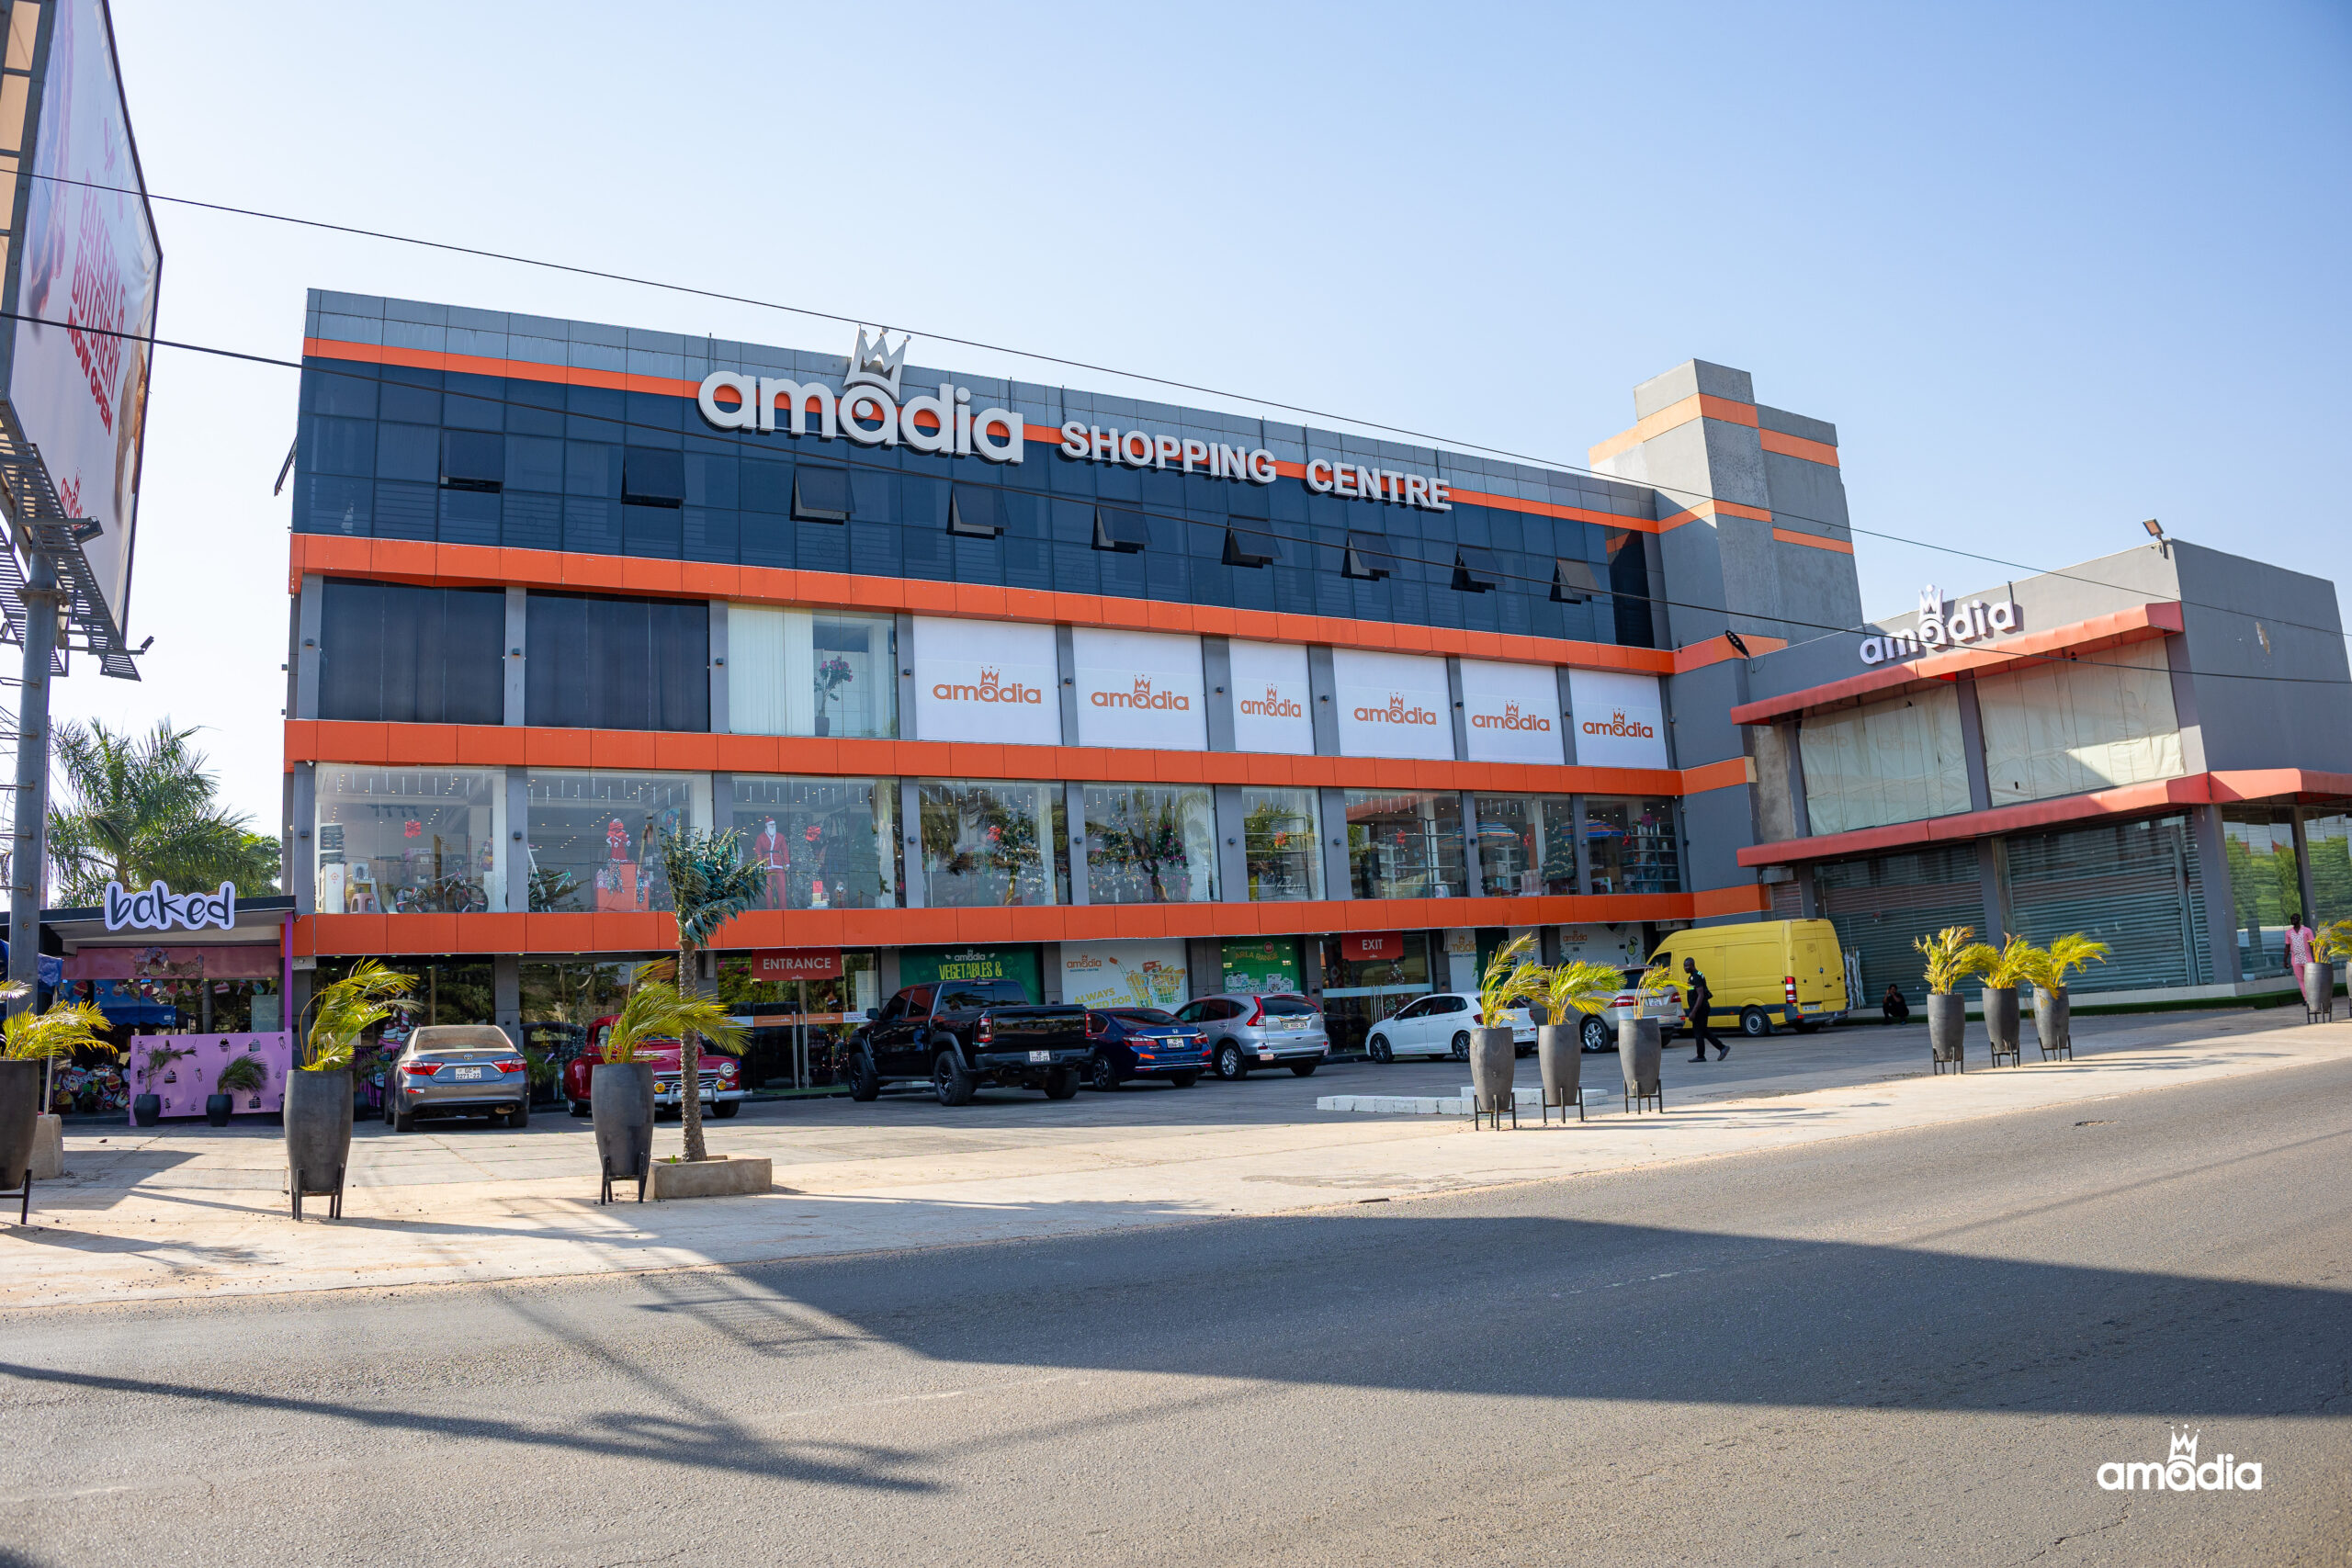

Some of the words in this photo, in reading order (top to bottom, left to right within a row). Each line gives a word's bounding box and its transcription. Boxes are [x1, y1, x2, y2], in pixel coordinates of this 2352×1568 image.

[80, 167, 120, 321] BAKERY
[117, 284, 125, 346] &
[71, 235, 121, 402] BUTCHERY
[67, 305, 92, 379] NOW
[90, 366, 112, 437] OPEN
[698, 370, 1023, 464] amadia
[1060, 421, 1277, 484] SHOPPING
[1306, 458, 1452, 511] CENTRE
[1860, 599, 2016, 664] amadia
[933, 682, 1042, 705] amadia
[1091, 689, 1189, 711] amadia
[1240, 698, 1301, 718] amadia
[1353, 705, 1437, 726] amadia
[1472, 712, 1550, 732] amadia
[1582, 719, 1653, 739] amadia
[109, 885, 231, 925] baked
[1362, 939, 1383, 950] EXIT
[763, 958, 831, 970] ENTRANCE
[954, 953, 986, 962] amadia
[1067, 958, 1102, 968] amadia
[939, 961, 993, 980] VEGETABLES
[995, 961, 1003, 977] &
[1074, 987, 1115, 1004] ALWAYS
[1111, 995, 1132, 1006] FOR
